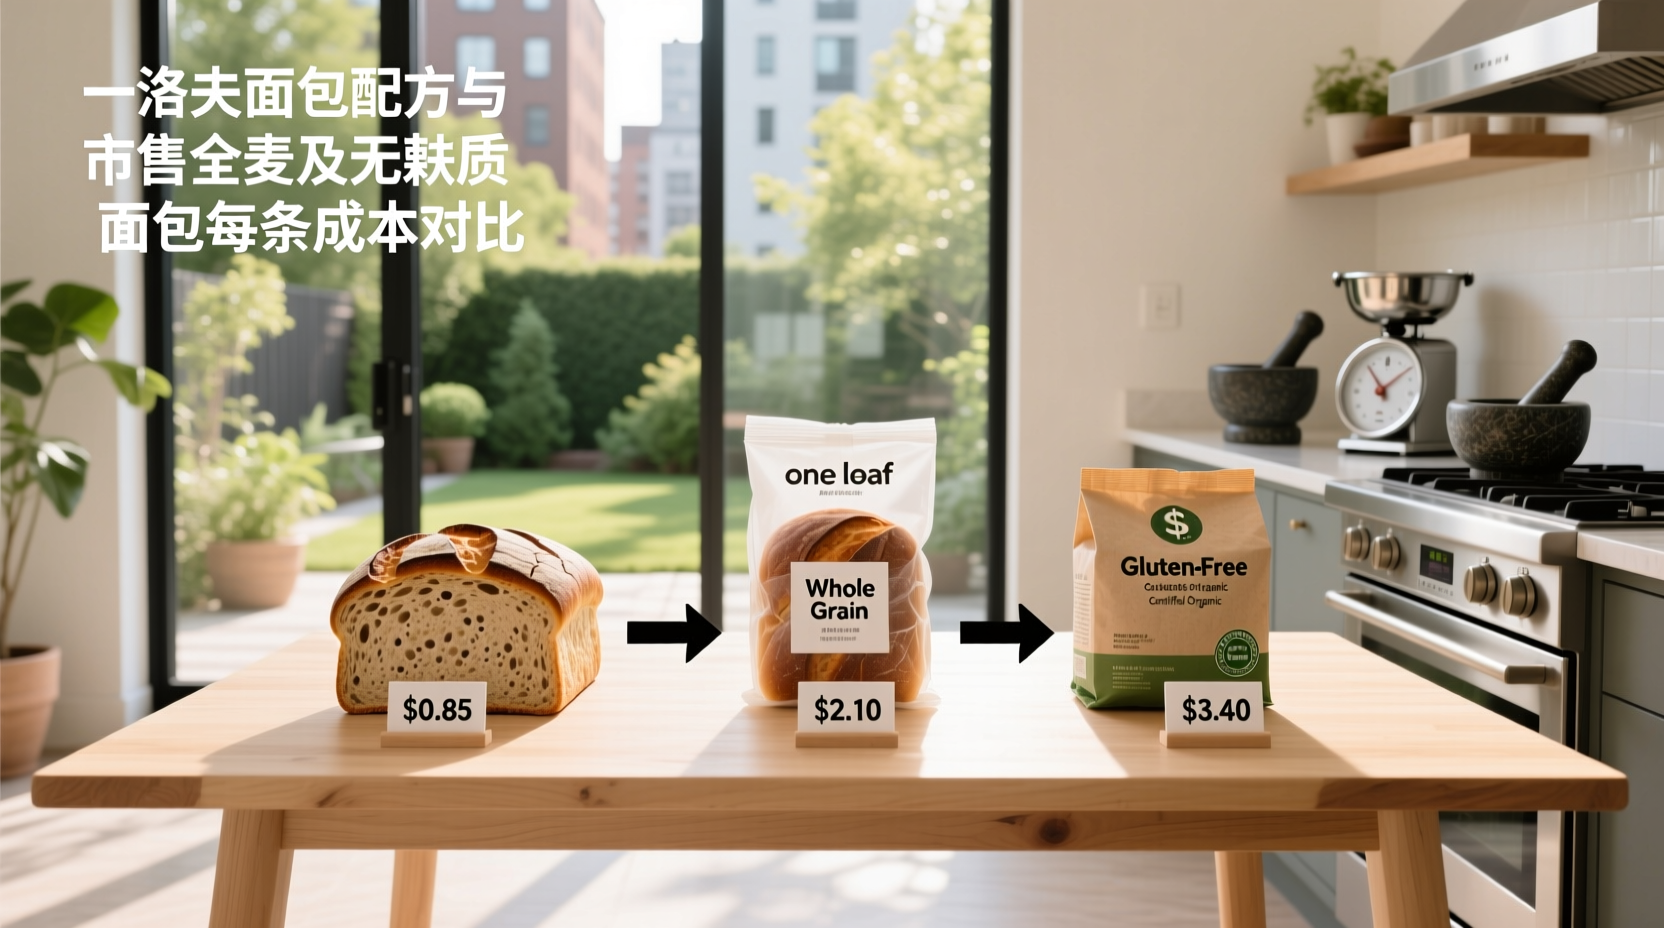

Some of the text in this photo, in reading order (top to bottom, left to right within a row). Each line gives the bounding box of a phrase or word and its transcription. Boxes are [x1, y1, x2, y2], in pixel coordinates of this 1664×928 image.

[785, 461, 895, 485] one loaf
[1120, 555, 1248, 576] Gluten-Free
[805, 577, 876, 598] Whole
[810, 600, 869, 621] Grain
[402, 694, 472, 724] $0.85
[814, 694, 882, 724] $2.10
[1182, 694, 1251, 724] $3.40
